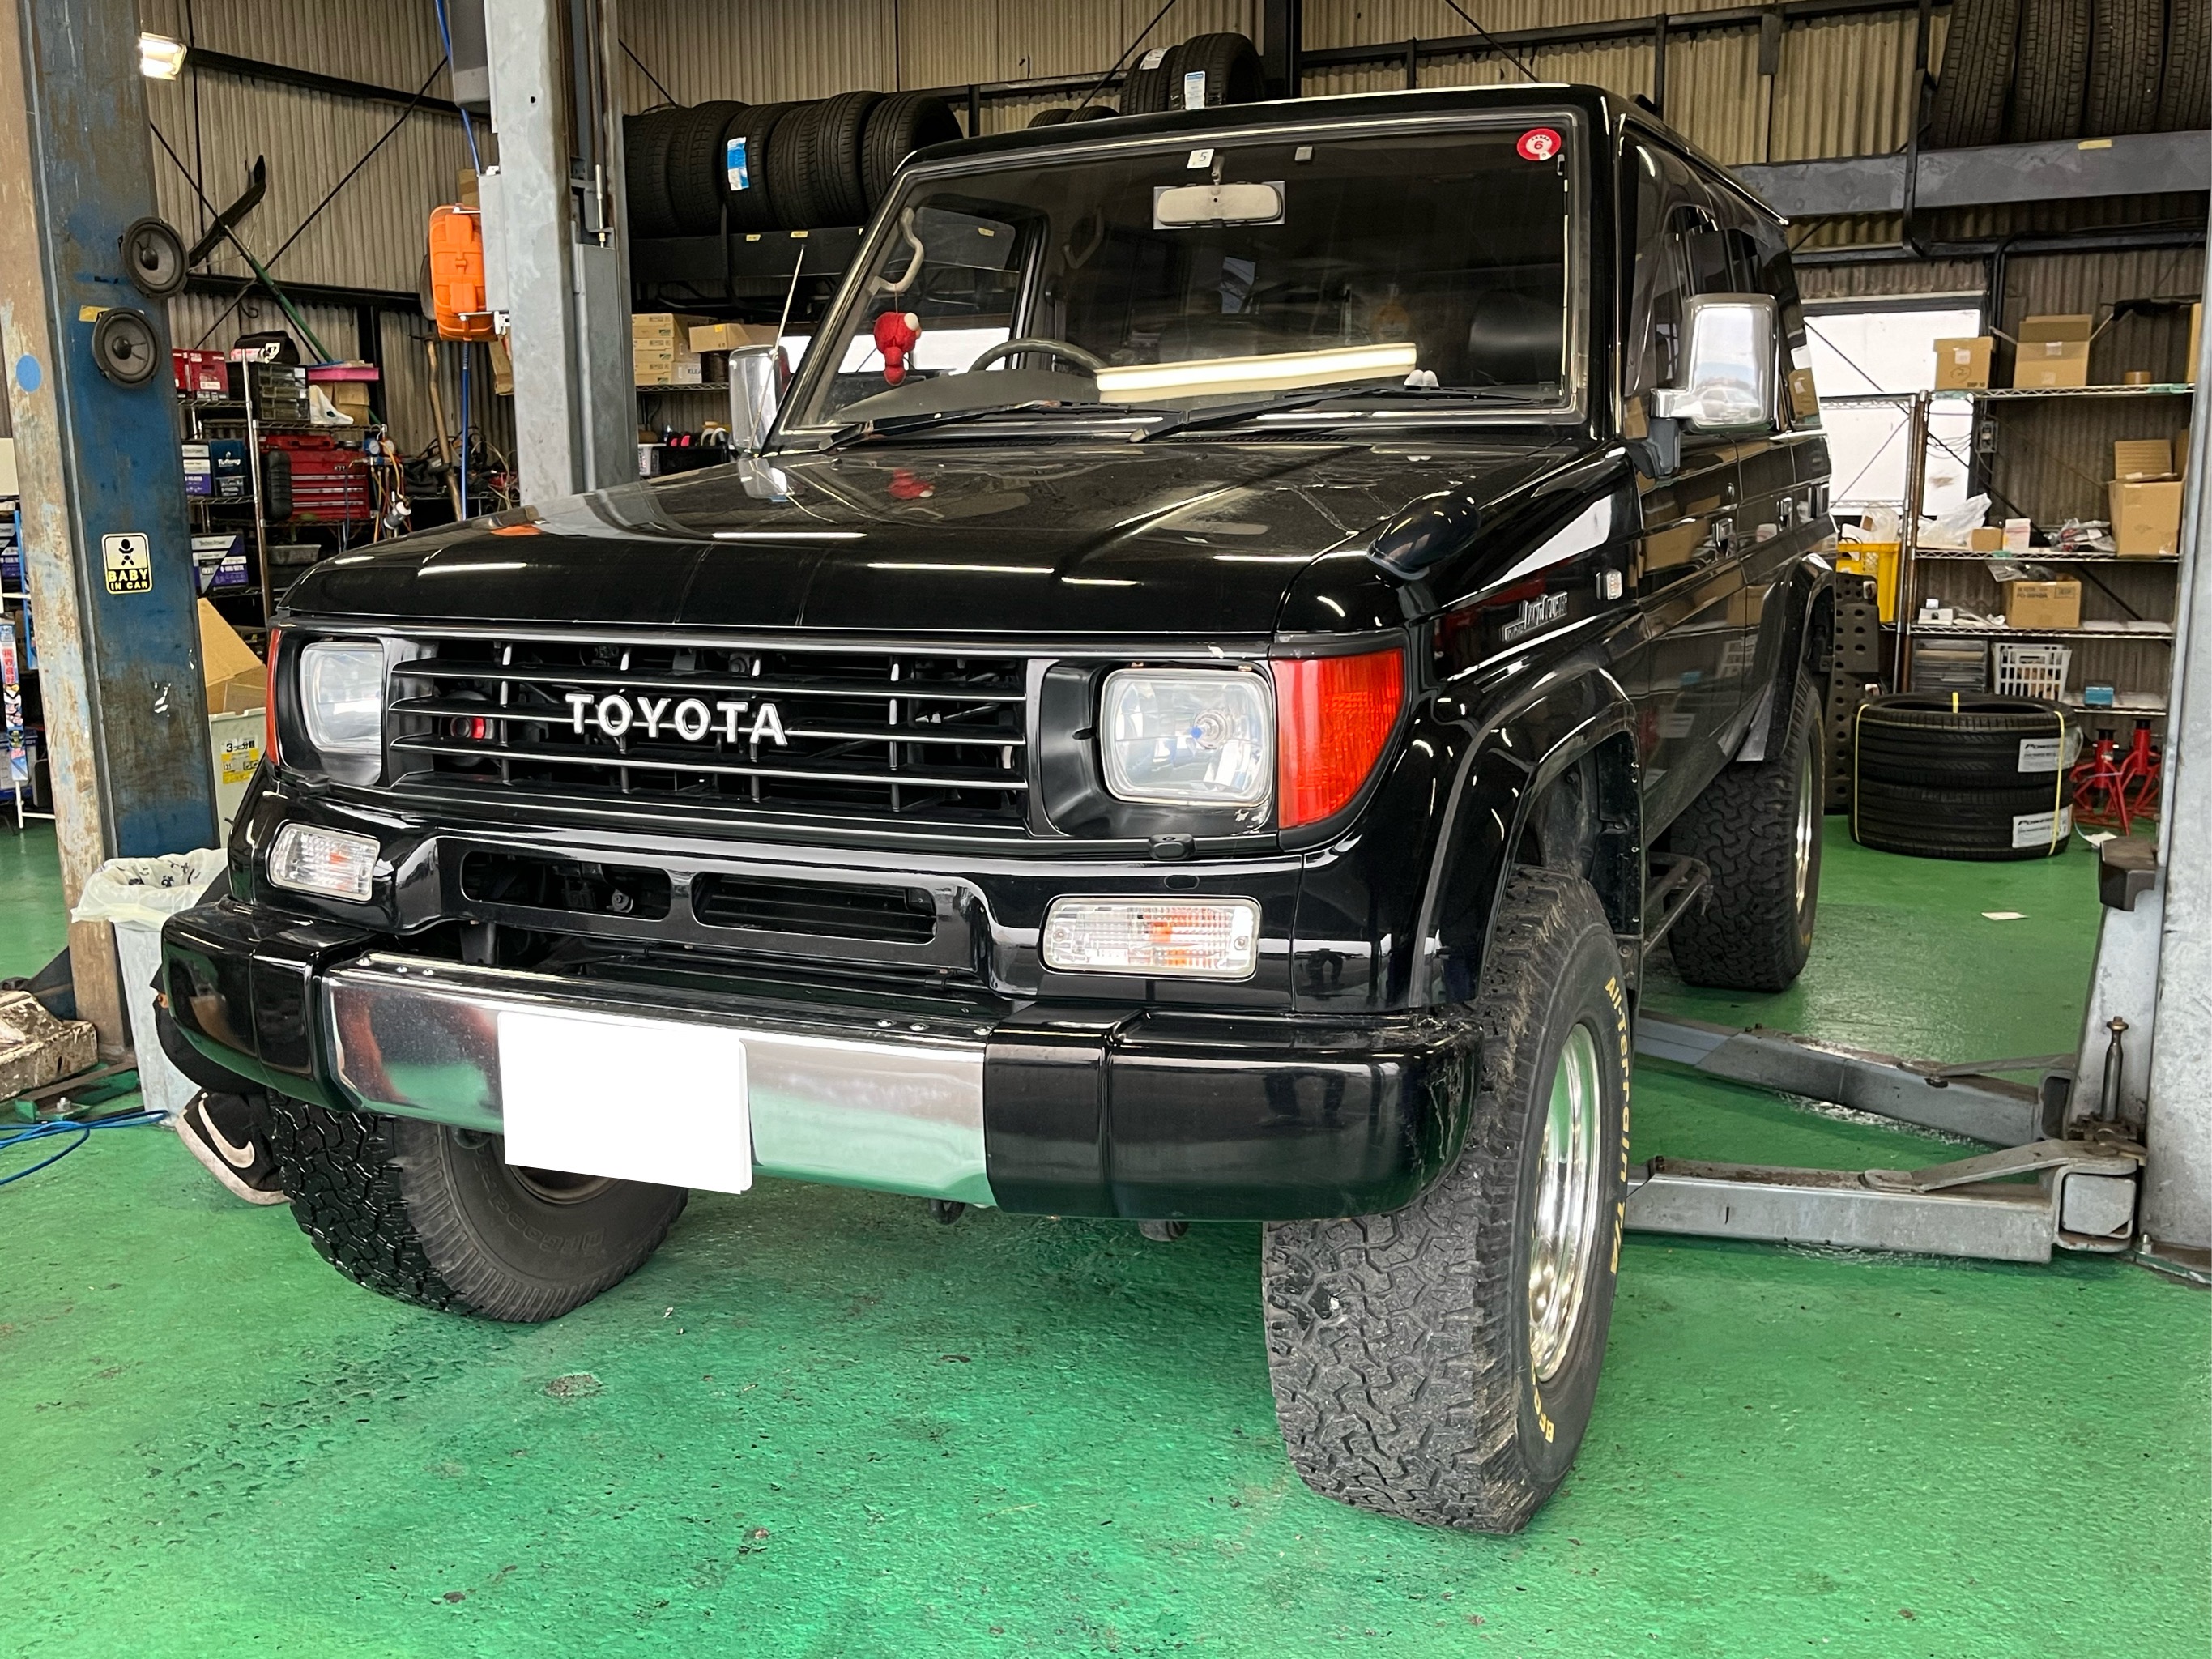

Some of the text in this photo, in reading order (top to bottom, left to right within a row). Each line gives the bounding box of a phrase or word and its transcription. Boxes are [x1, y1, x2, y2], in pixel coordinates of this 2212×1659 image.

[108, 569, 148, 582] BABY
[110, 581, 148, 591] IN CAR
[565, 693, 789, 748] TOYOTA
[1605, 976, 1630, 1275] All-Terrain T/A
